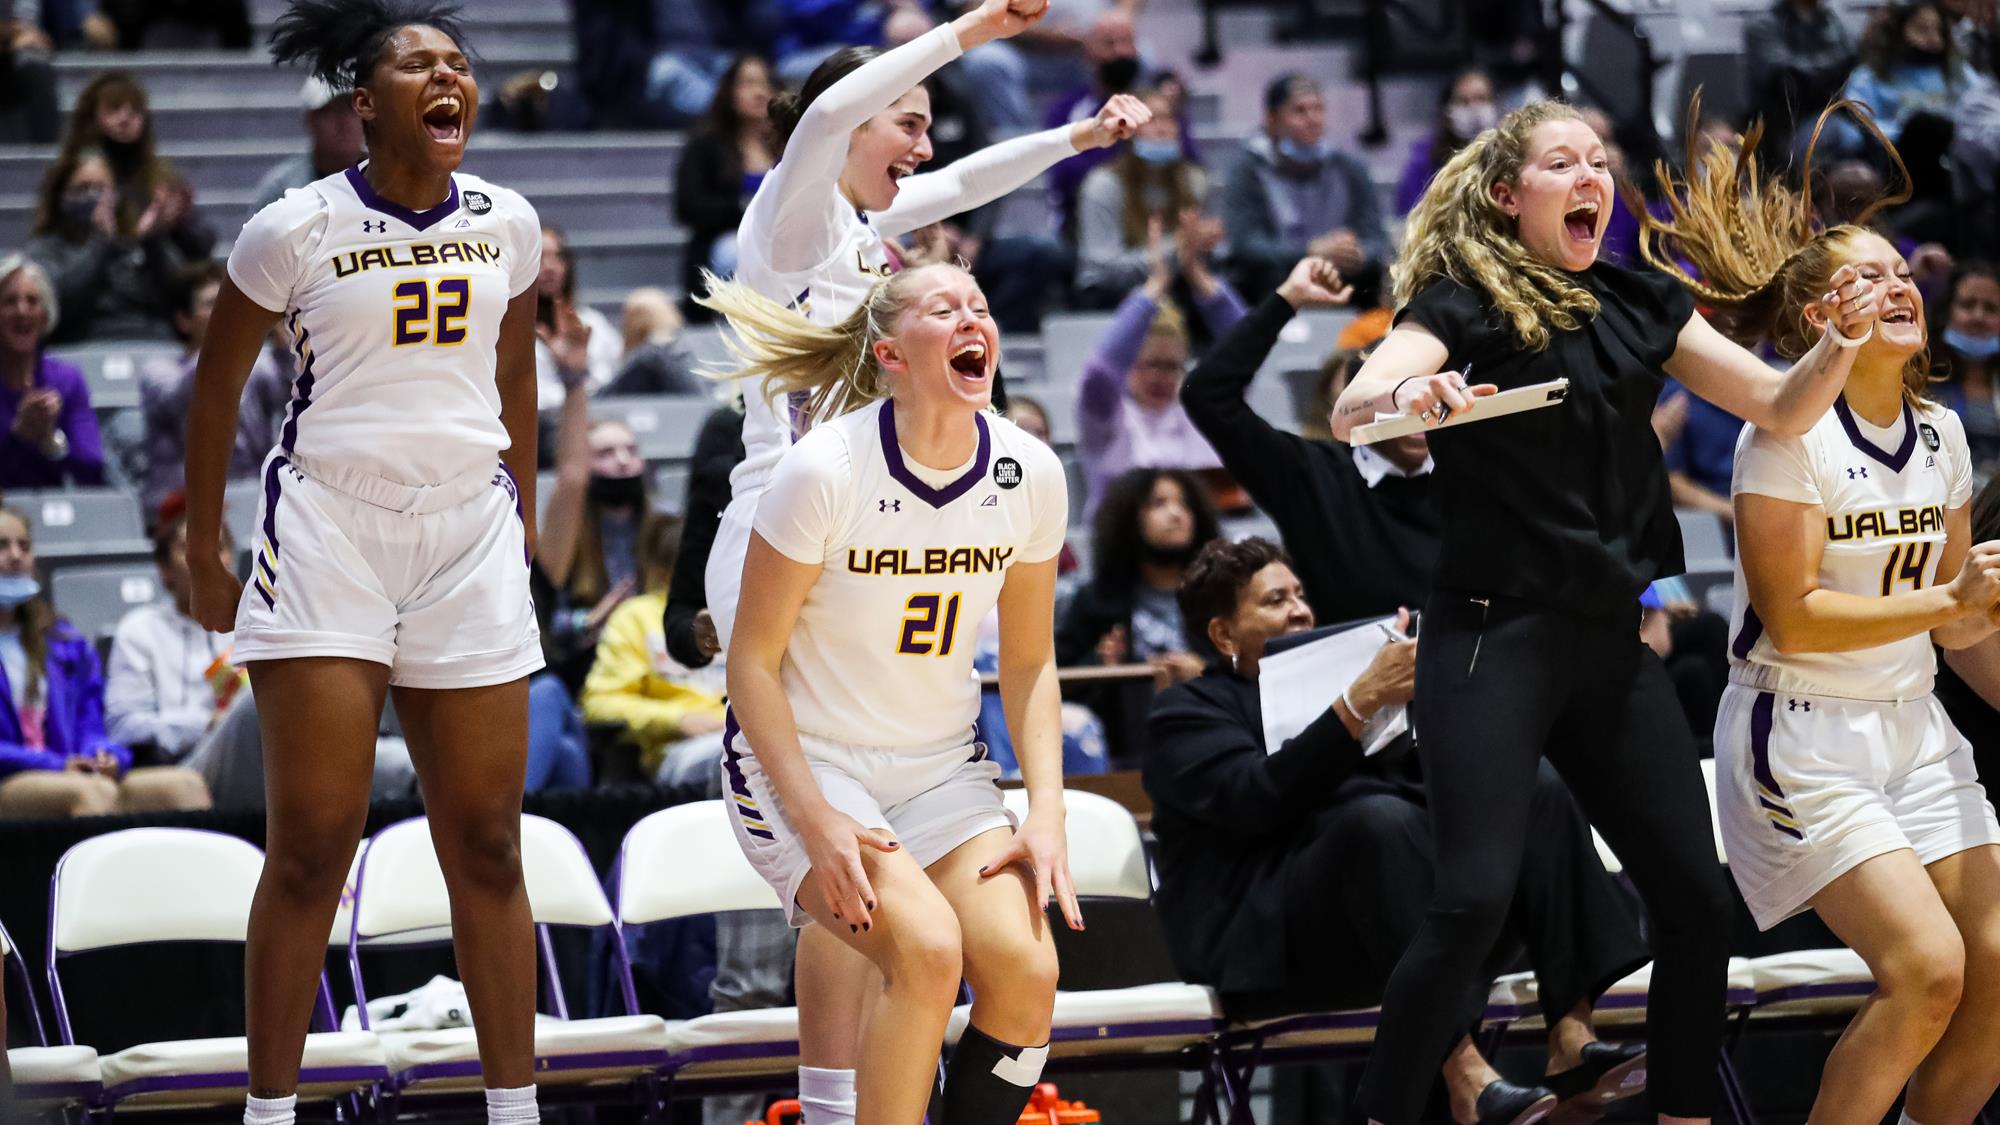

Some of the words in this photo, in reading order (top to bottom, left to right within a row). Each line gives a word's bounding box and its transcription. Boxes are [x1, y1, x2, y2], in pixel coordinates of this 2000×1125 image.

[332, 241, 501, 279] UALBANY
[392, 276, 472, 347] 22
[847, 546, 1014, 576] UALBANY
[1881, 541, 1932, 597] 14
[895, 591, 962, 657] 21
